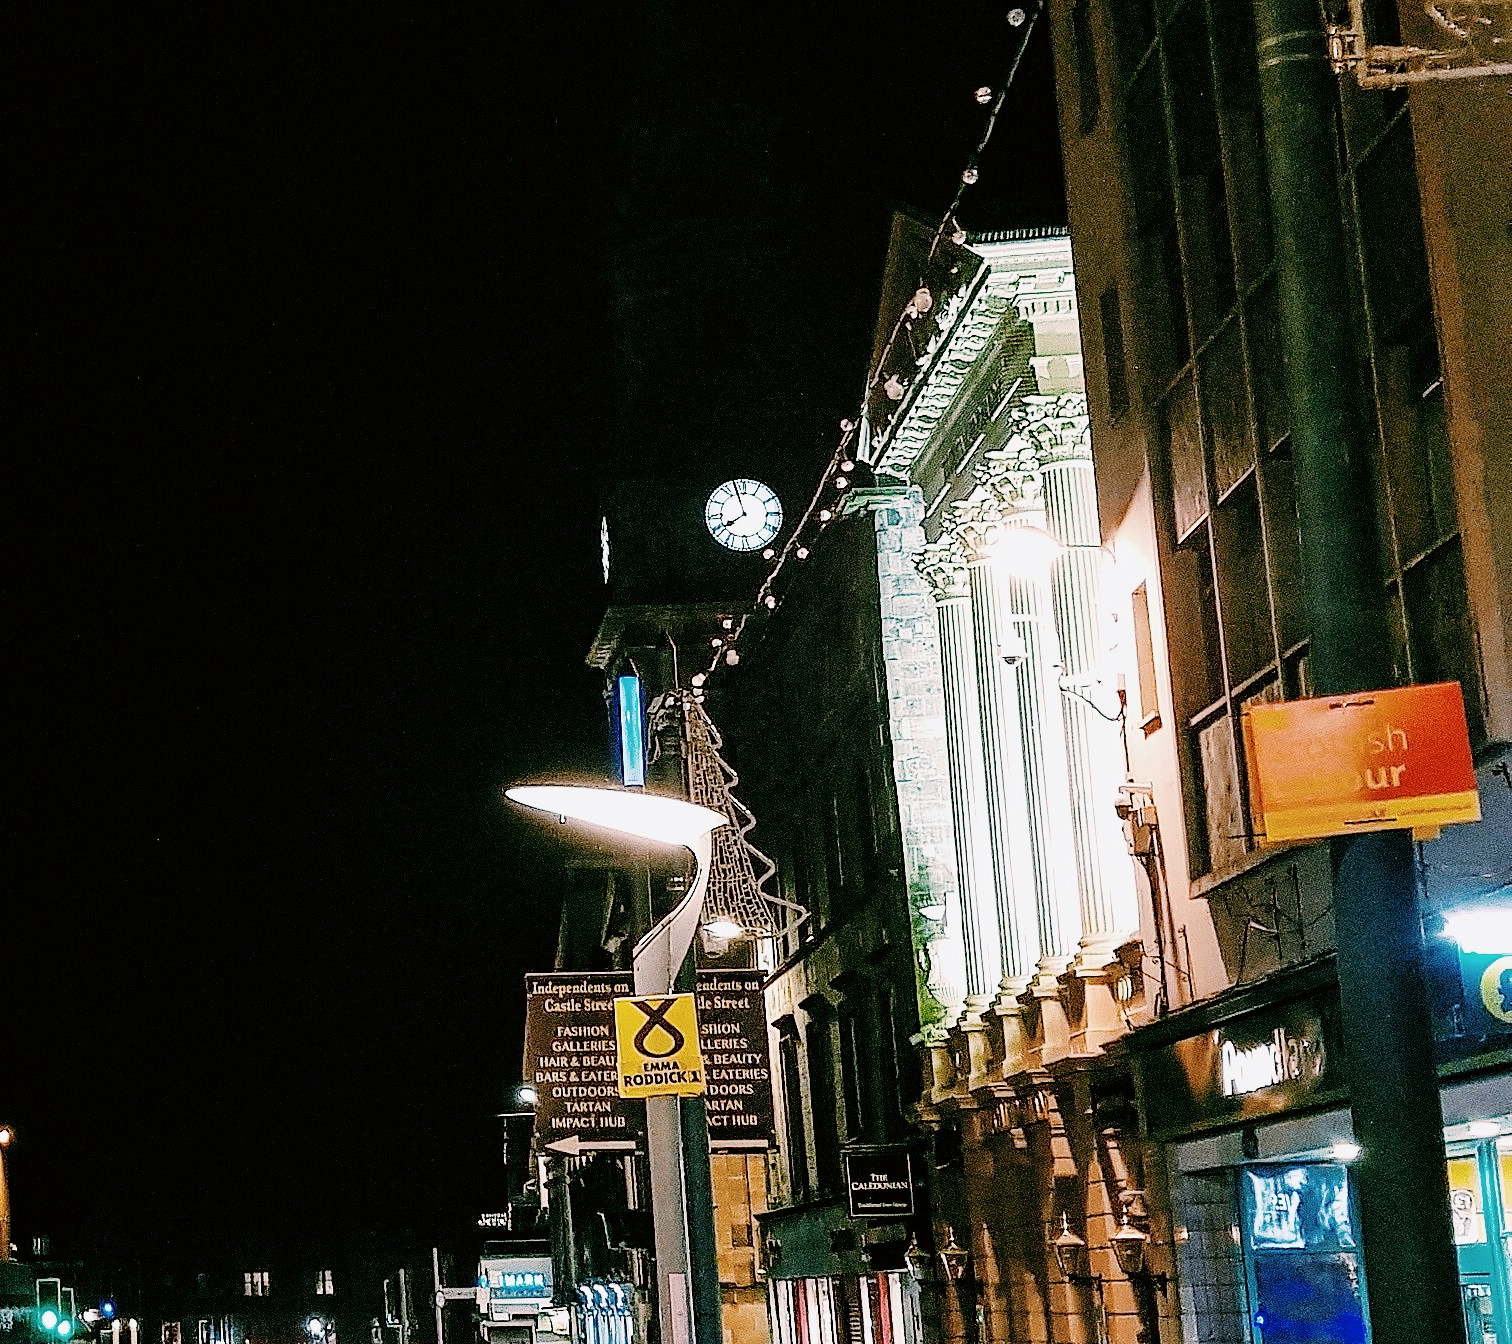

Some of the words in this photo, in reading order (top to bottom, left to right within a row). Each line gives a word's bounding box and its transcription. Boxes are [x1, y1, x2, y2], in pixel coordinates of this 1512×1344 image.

[532, 980, 611, 997] Independents
[613, 983, 629, 993] on
[696, 977, 742, 992] endents
[744, 981, 759, 991] on
[544, 998, 582, 1012] Castle
[583, 998, 613, 1011] Stree
[714, 996, 750, 1010] Street
[557, 1026, 608, 1037] FASHION
[701, 1023, 740, 1035] SHION
[551, 1040, 616, 1052] GALLERIES
[700, 1038, 748, 1050] LLERIES
[539, 1056, 568, 1068] HAIR
[570, 1056, 580, 1067] &
[582, 1056, 615, 1067] BEAU
[713, 1053, 762, 1065] BEAUTY
[643, 1061, 680, 1072] EMMA
[535, 1071, 567, 1083] BARS
[569, 1071, 579, 1083] &
[581, 1070, 618, 1082] EATER
[623, 1071, 687, 1087] RODDICK
[713, 1068, 768, 1080] EATERIES
[704, 1084, 755, 1096] DOORS
[565, 1101, 611, 1113] TARTAN
[704, 1099, 743, 1111] ARTAN
[551, 1116, 595, 1128] IMPACT
[600, 1116, 626, 1128] HUB
[706, 1115, 729, 1127] ACT
[732, 1115, 758, 1126] HUB
[870, 1173, 888, 1182] THE
[851, 1181, 908, 1191] CALEDONIAN
